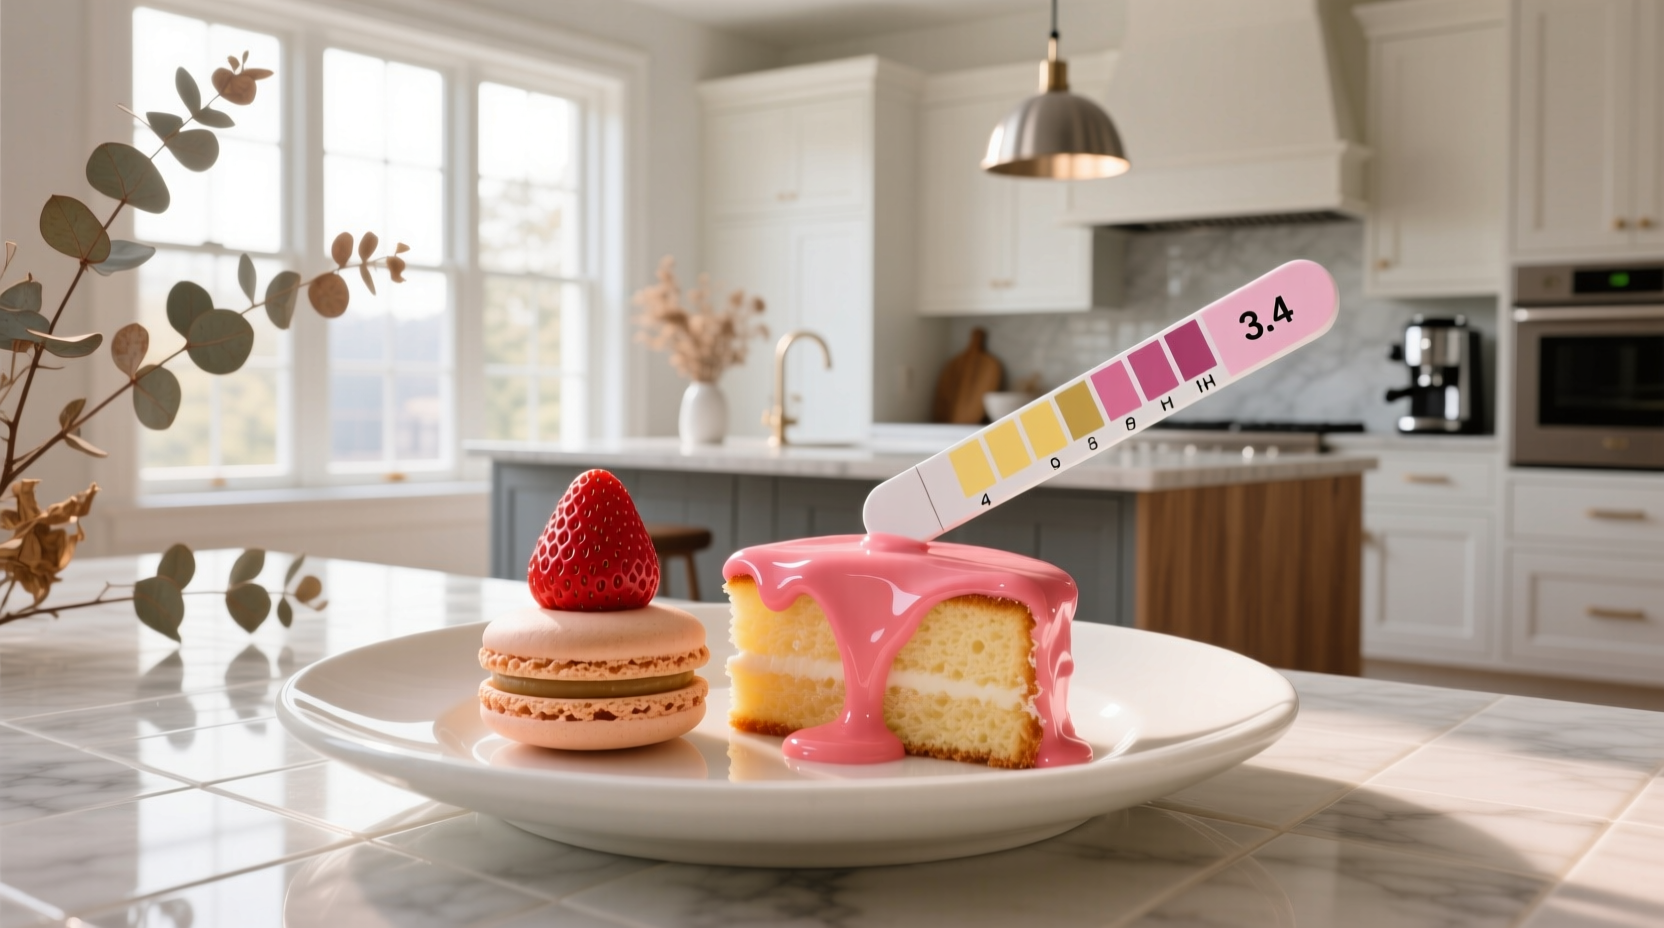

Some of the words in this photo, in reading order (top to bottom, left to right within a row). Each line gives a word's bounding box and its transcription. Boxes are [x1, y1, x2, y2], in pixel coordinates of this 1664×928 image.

[1239, 295, 1293, 341] 3.4
[981, 493, 992, 507] 4
[1160, 395, 1174, 412] H
